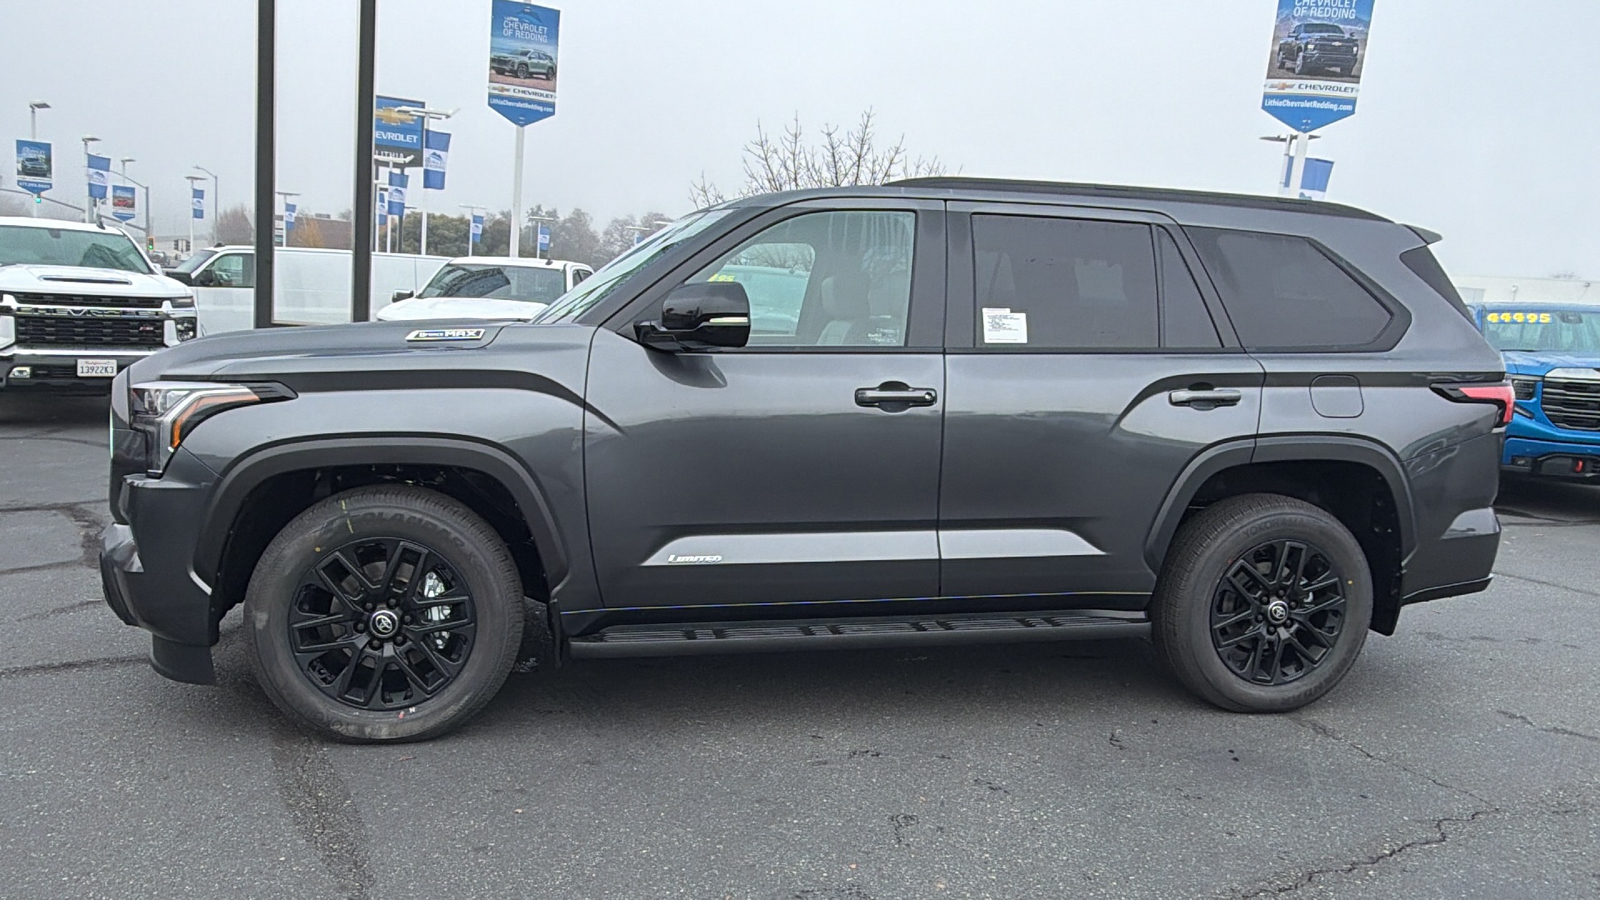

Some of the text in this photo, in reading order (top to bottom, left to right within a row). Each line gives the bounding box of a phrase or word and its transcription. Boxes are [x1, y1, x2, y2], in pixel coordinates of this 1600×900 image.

[1294, 0, 1357, 8] CHEVROLET
[1293, 7, 1356, 19] OF REDDING
[503, 20, 548, 34] CHEVROLET
[503, 28, 548, 43] OF REDDING
[513, 88, 554, 99] CHEVROLET
[1298, 83, 1355, 93] CHEVROLET
[1264, 98, 1353, 111] LithiaChevroletRedding.com
[375, 130, 418, 143] EVROLET
[15, 307, 166, 318] CHEVROLET
[1487, 312, 1550, 323] 44495
[80, 365, 114, 374] 13922K3
